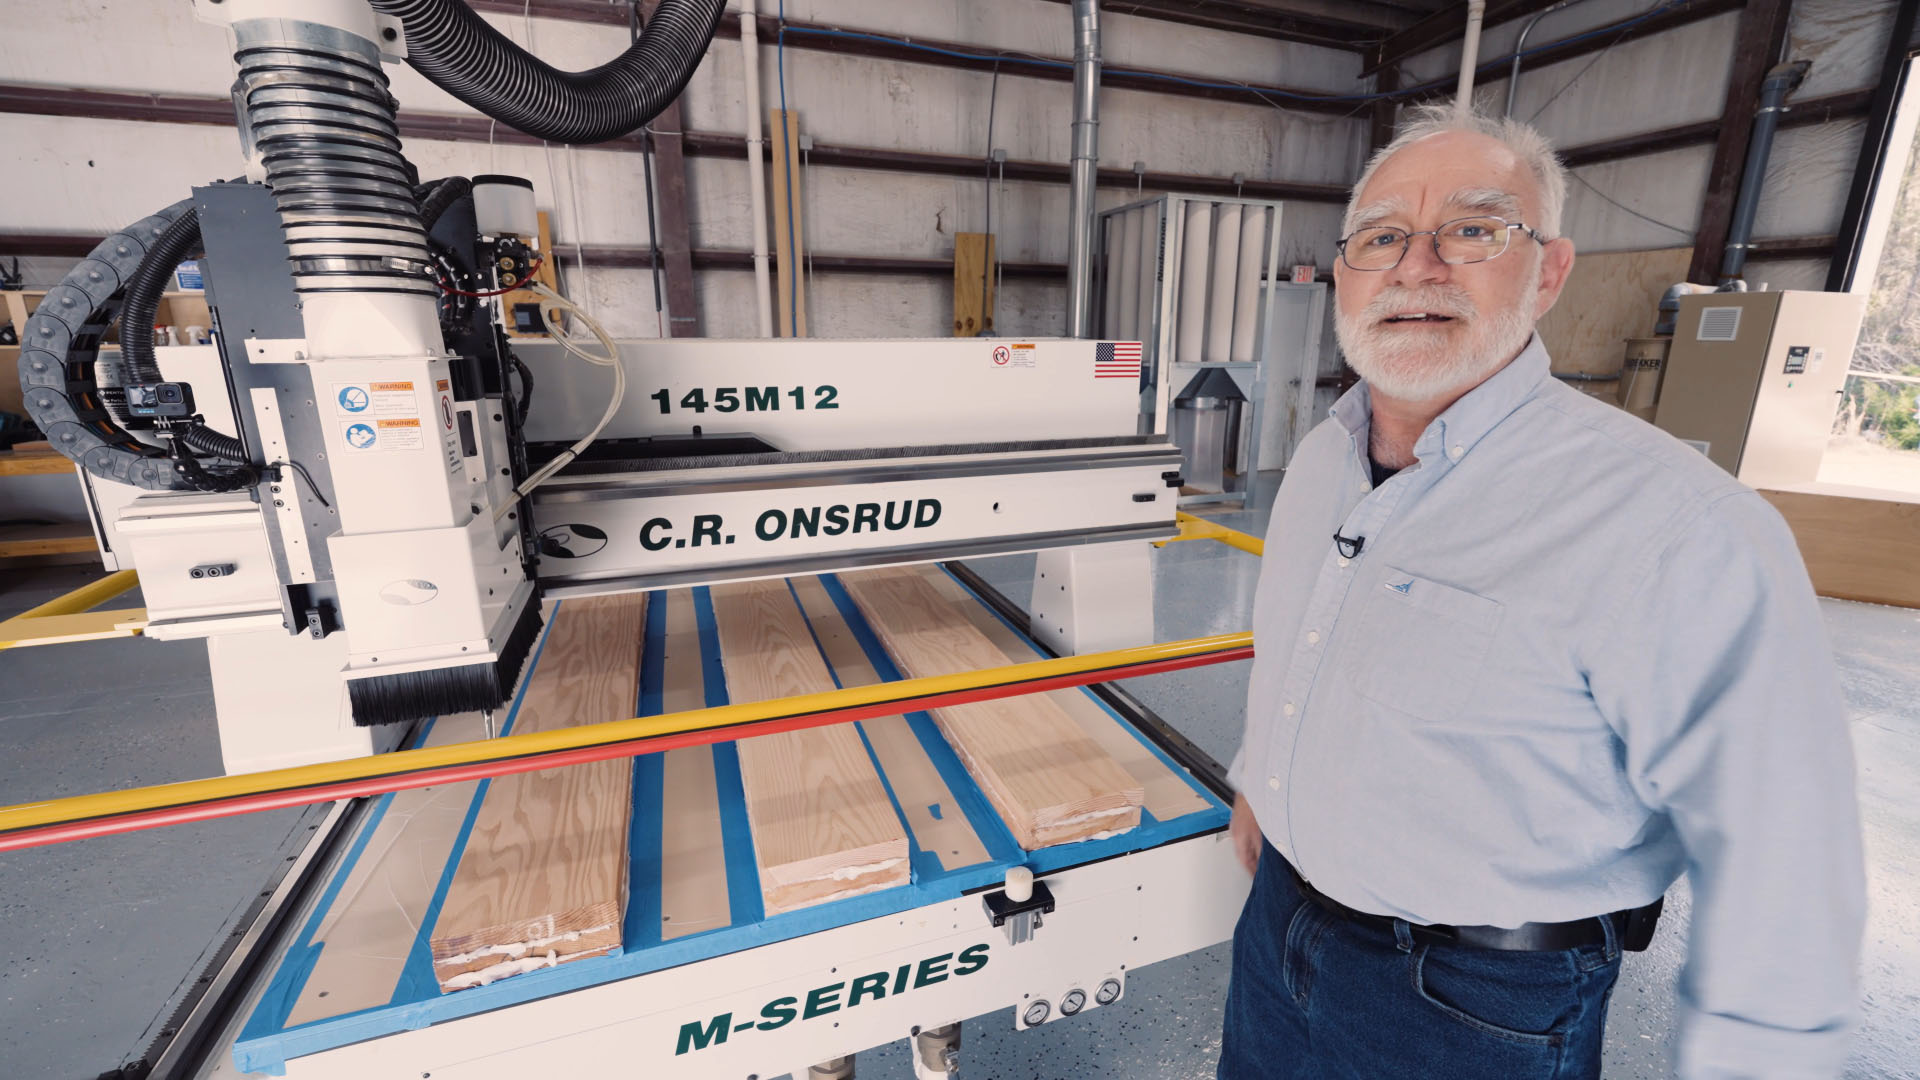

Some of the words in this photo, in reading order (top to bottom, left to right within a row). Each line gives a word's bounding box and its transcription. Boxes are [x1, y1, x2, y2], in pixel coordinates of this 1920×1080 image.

[650, 385, 840, 415] 145M12
[639, 515, 736, 551] C.R.
[755, 498, 942, 541] ONSRUD
[675, 943, 991, 1057] M-SERIES
